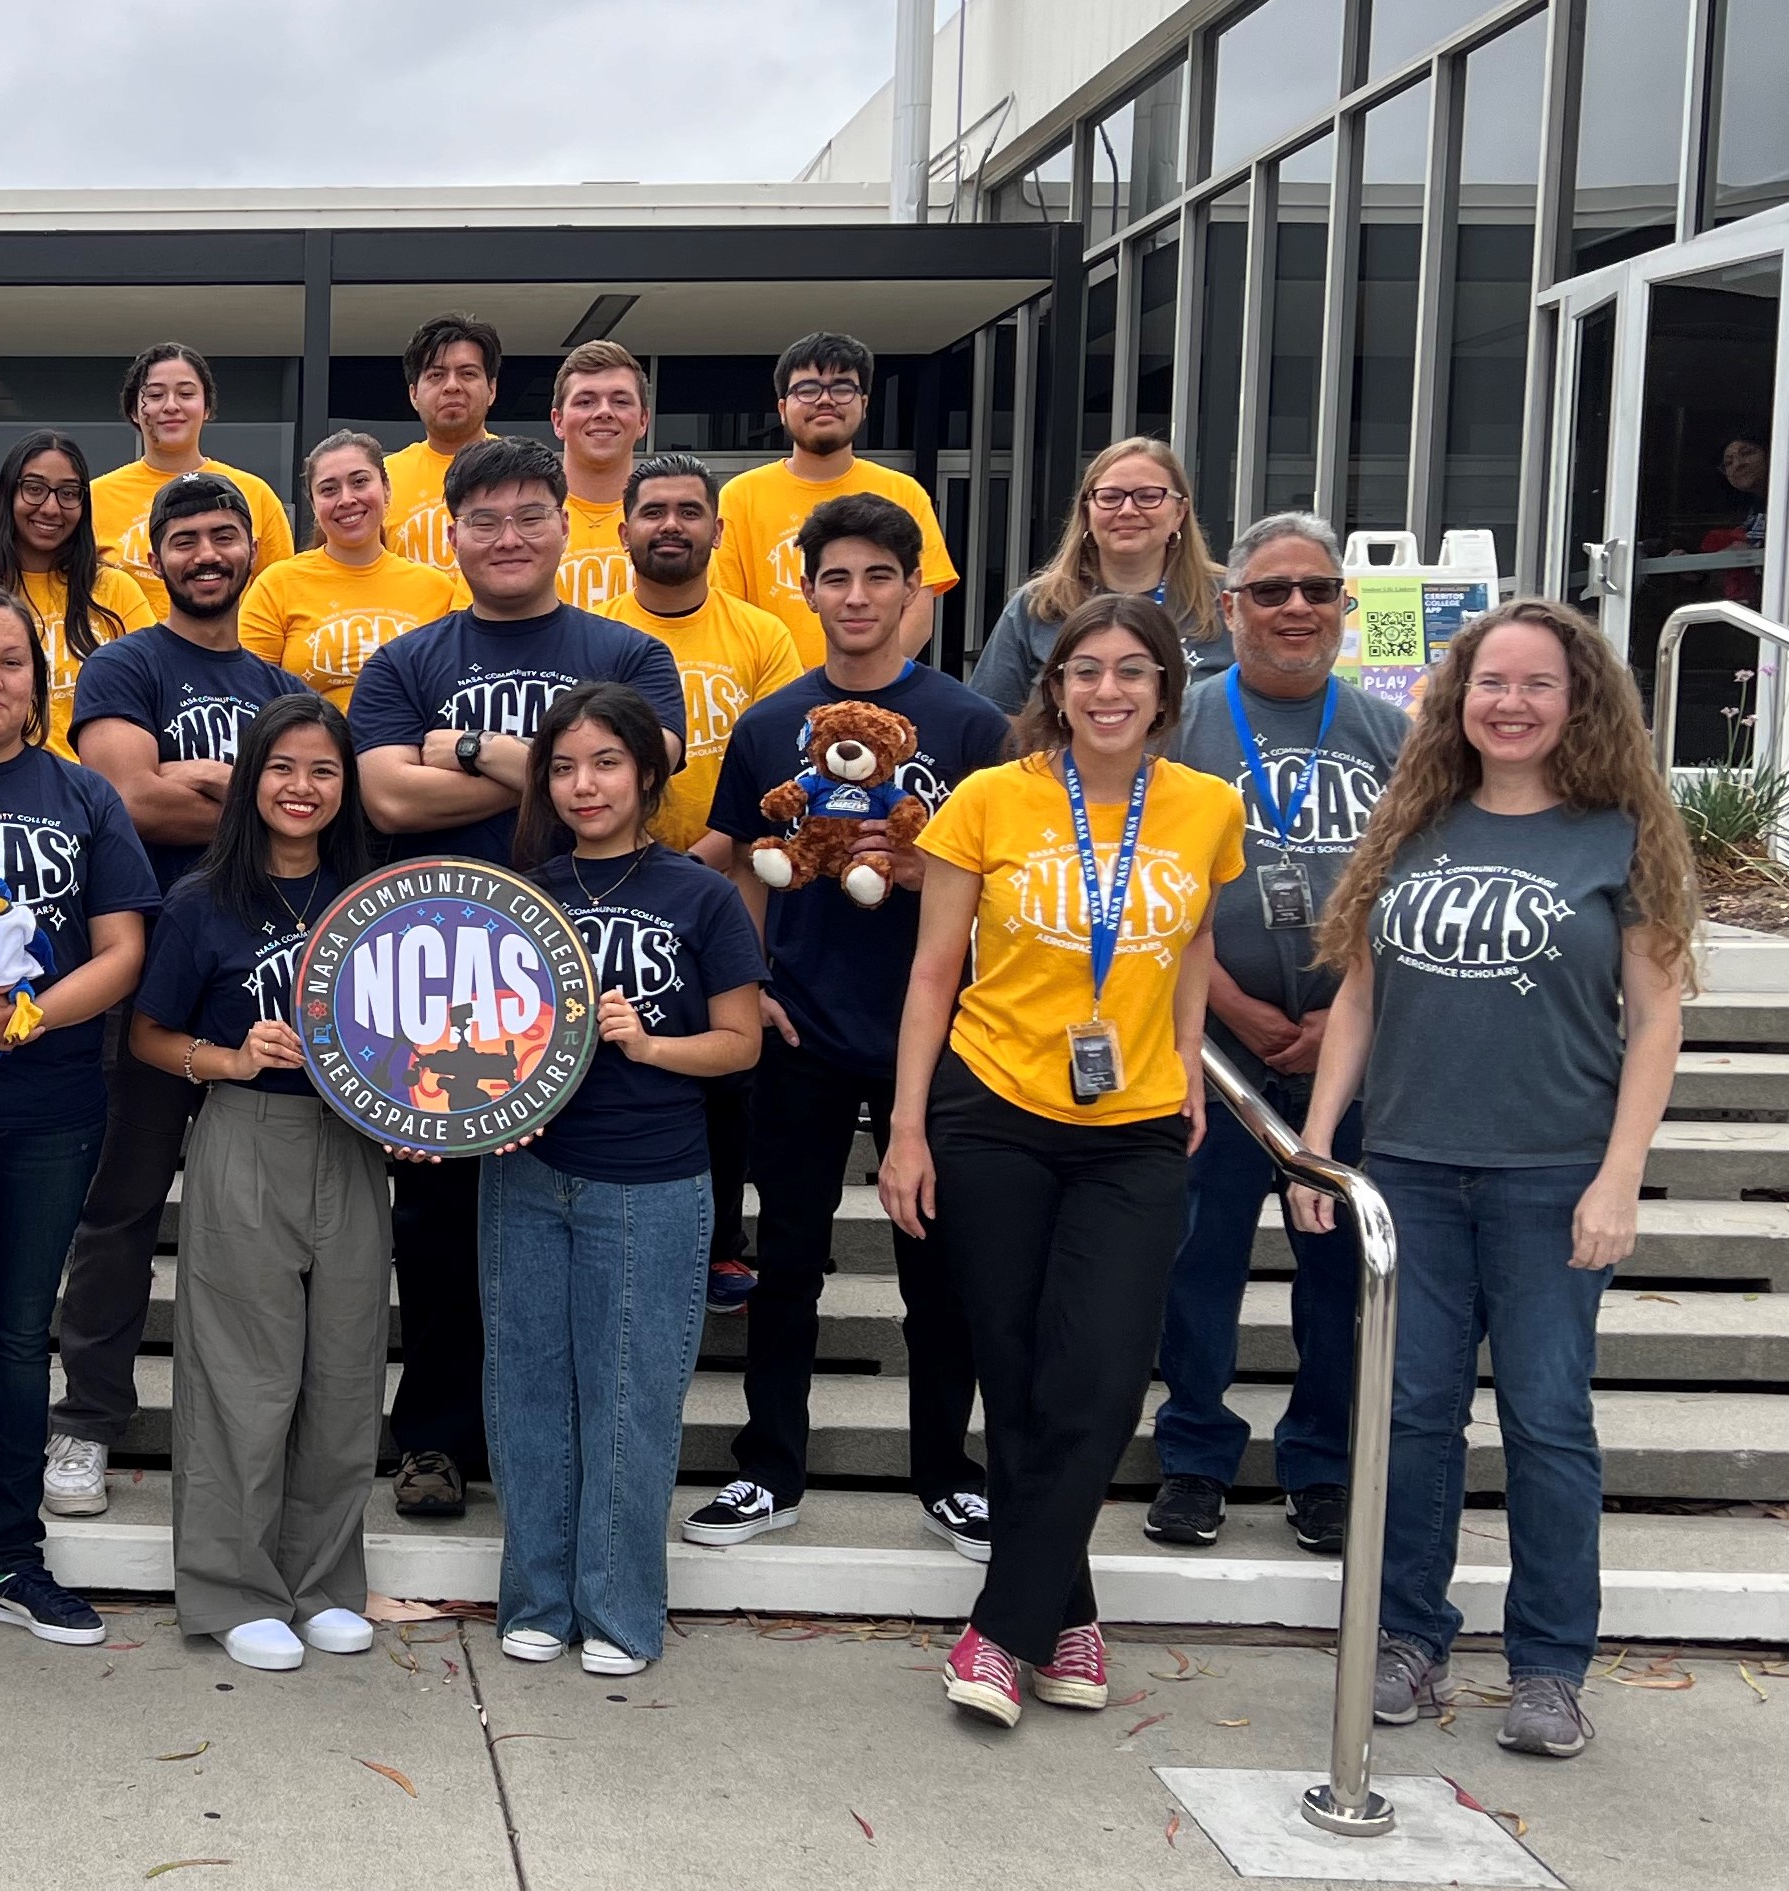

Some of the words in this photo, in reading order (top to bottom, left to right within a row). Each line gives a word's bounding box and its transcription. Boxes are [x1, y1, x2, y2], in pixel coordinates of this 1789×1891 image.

[405, 504, 460, 570] NC
[557, 555, 637, 609] NCA
[1425, 599, 1461, 607] COLLEGE
[457, 675, 483, 686] NASA
[485, 669, 537, 680] COMMUNITY
[540, 671, 579, 686] COLLEGE
[1364, 675, 1407, 691] PLAY
[451, 679, 573, 738] NCA
[680, 670, 740, 748] AS
[1380, 690, 1408, 707] Day
[177, 704, 256, 768] NC
[687, 745, 723, 758] CHOLARS
[1270, 747, 1328, 757] COMMUNTY
[1331, 751, 1376, 772] COLLEGE
[1066, 768, 1080, 800] NASA
[1132, 777, 1145, 807] NASA
[1236, 755, 1381, 843] NCAS
[17, 814, 61, 827] COLLEGE
[1074, 808, 1089, 840] NASA
[1123, 816, 1139, 847] NASA
[1257, 839, 1316, 854] AEROPACE
[1317, 845, 1357, 854] SCHOLA
[1081, 850, 1096, 881] NASA
[1115, 856, 1131, 887] NASA
[1411, 869, 1442, 879] NASA
[1445, 865, 1511, 875] COMMUNITY
[1511, 868, 1558, 889] COLLEGE
[1021, 853, 1186, 942] NCAS
[1089, 890, 1103, 925] NASA
[568, 907, 628, 916] COMMUNITY
[630, 909, 675, 929] COLLEGE
[1107, 896, 1123, 931] NASA
[1383, 875, 1553, 965] NCAS
[255, 940, 281, 958] NASA
[308, 932, 349, 995] NASA
[347, 872, 501, 927] COMMUNITY
[509, 895, 584, 993] COLLEGE
[574, 916, 676, 1003] AS
[1397, 955, 1458, 978] AEROSPACE
[1460, 966, 1519, 979] SCHOLARS
[353, 924, 541, 1045] NCAS
[319, 1051, 448, 1140] AEROSPACE
[464, 1050, 576, 1139] SCHOLARS
